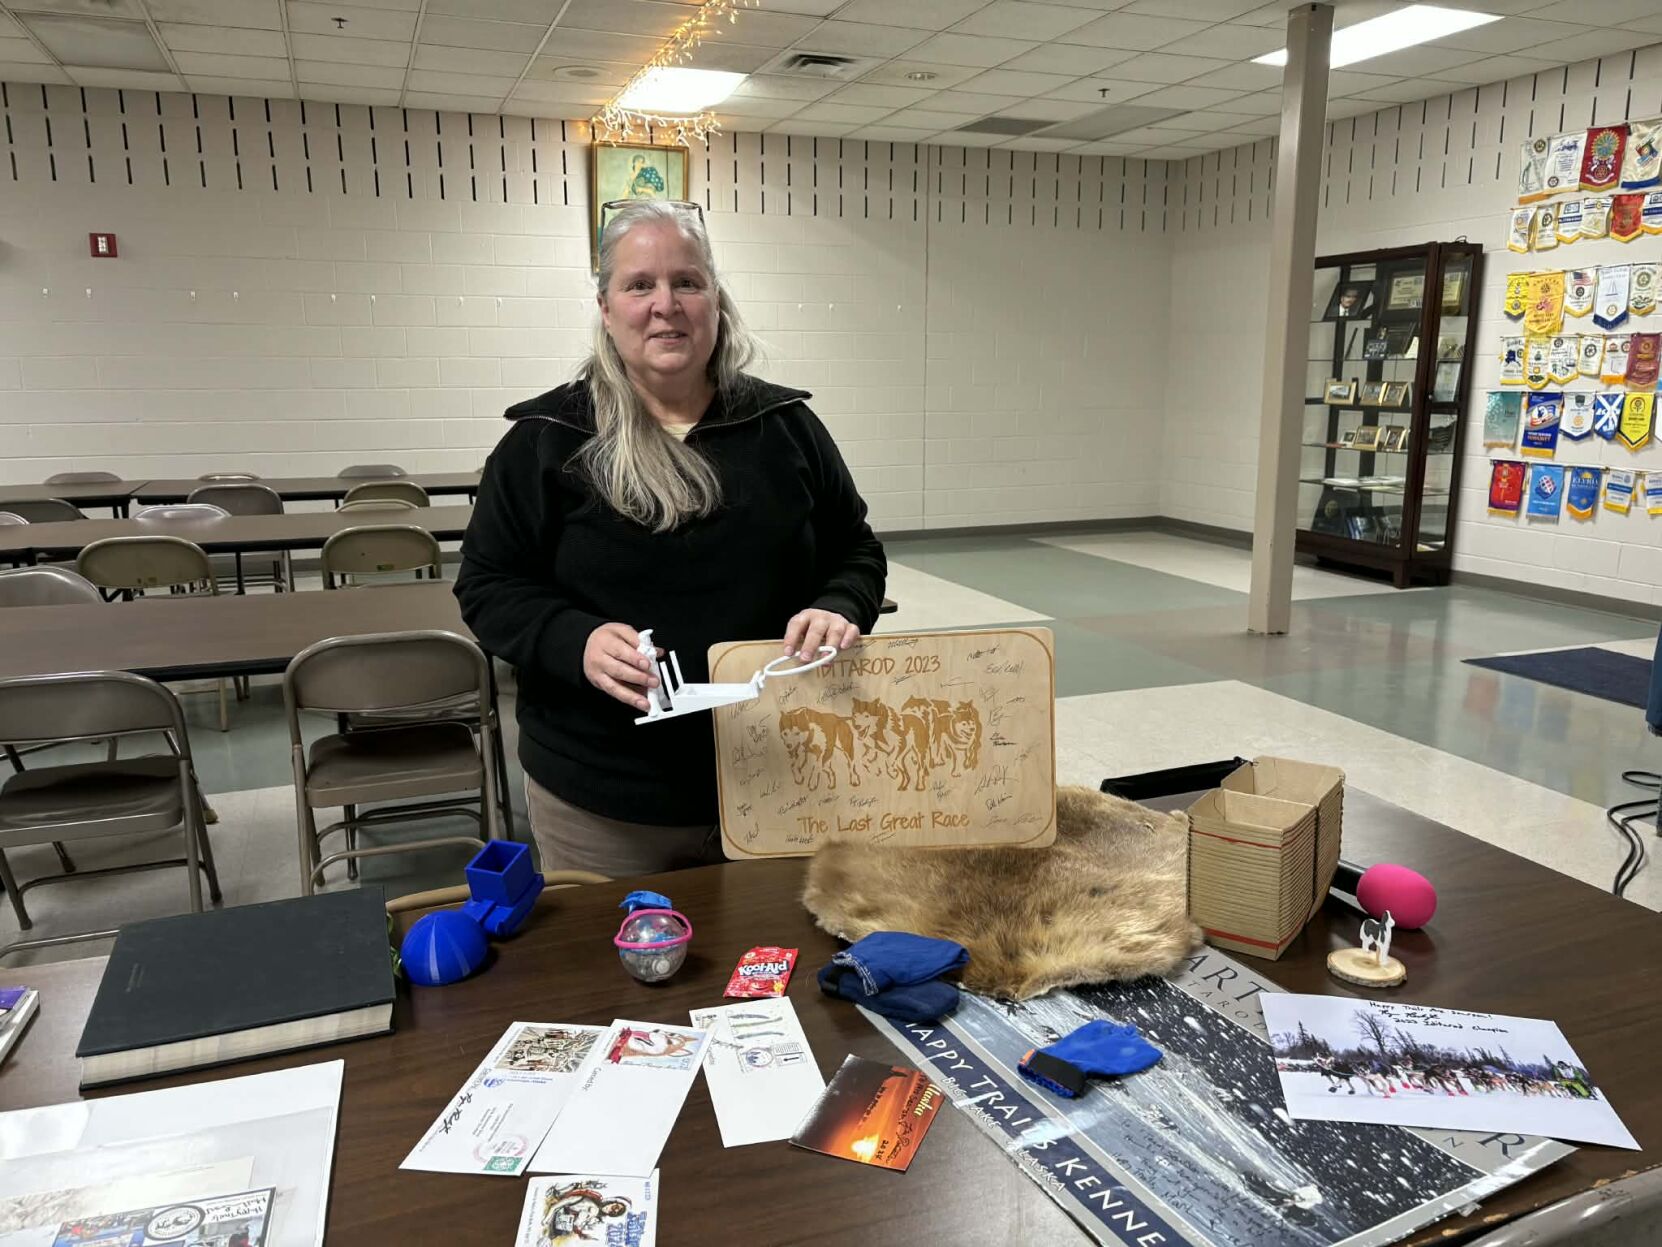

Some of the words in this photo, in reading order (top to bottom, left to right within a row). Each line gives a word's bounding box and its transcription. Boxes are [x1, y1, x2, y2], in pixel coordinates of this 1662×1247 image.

[905, 655, 941, 674] 2023
[797, 816, 829, 834] The
[836, 813, 873, 832] Last
[879, 811, 925, 831] Great
[931, 810, 970, 829] Race
[738, 960, 788, 976] Kool-Aid
[905, 1023, 974, 1069] APPY
[913, 1083, 943, 1116] laska
